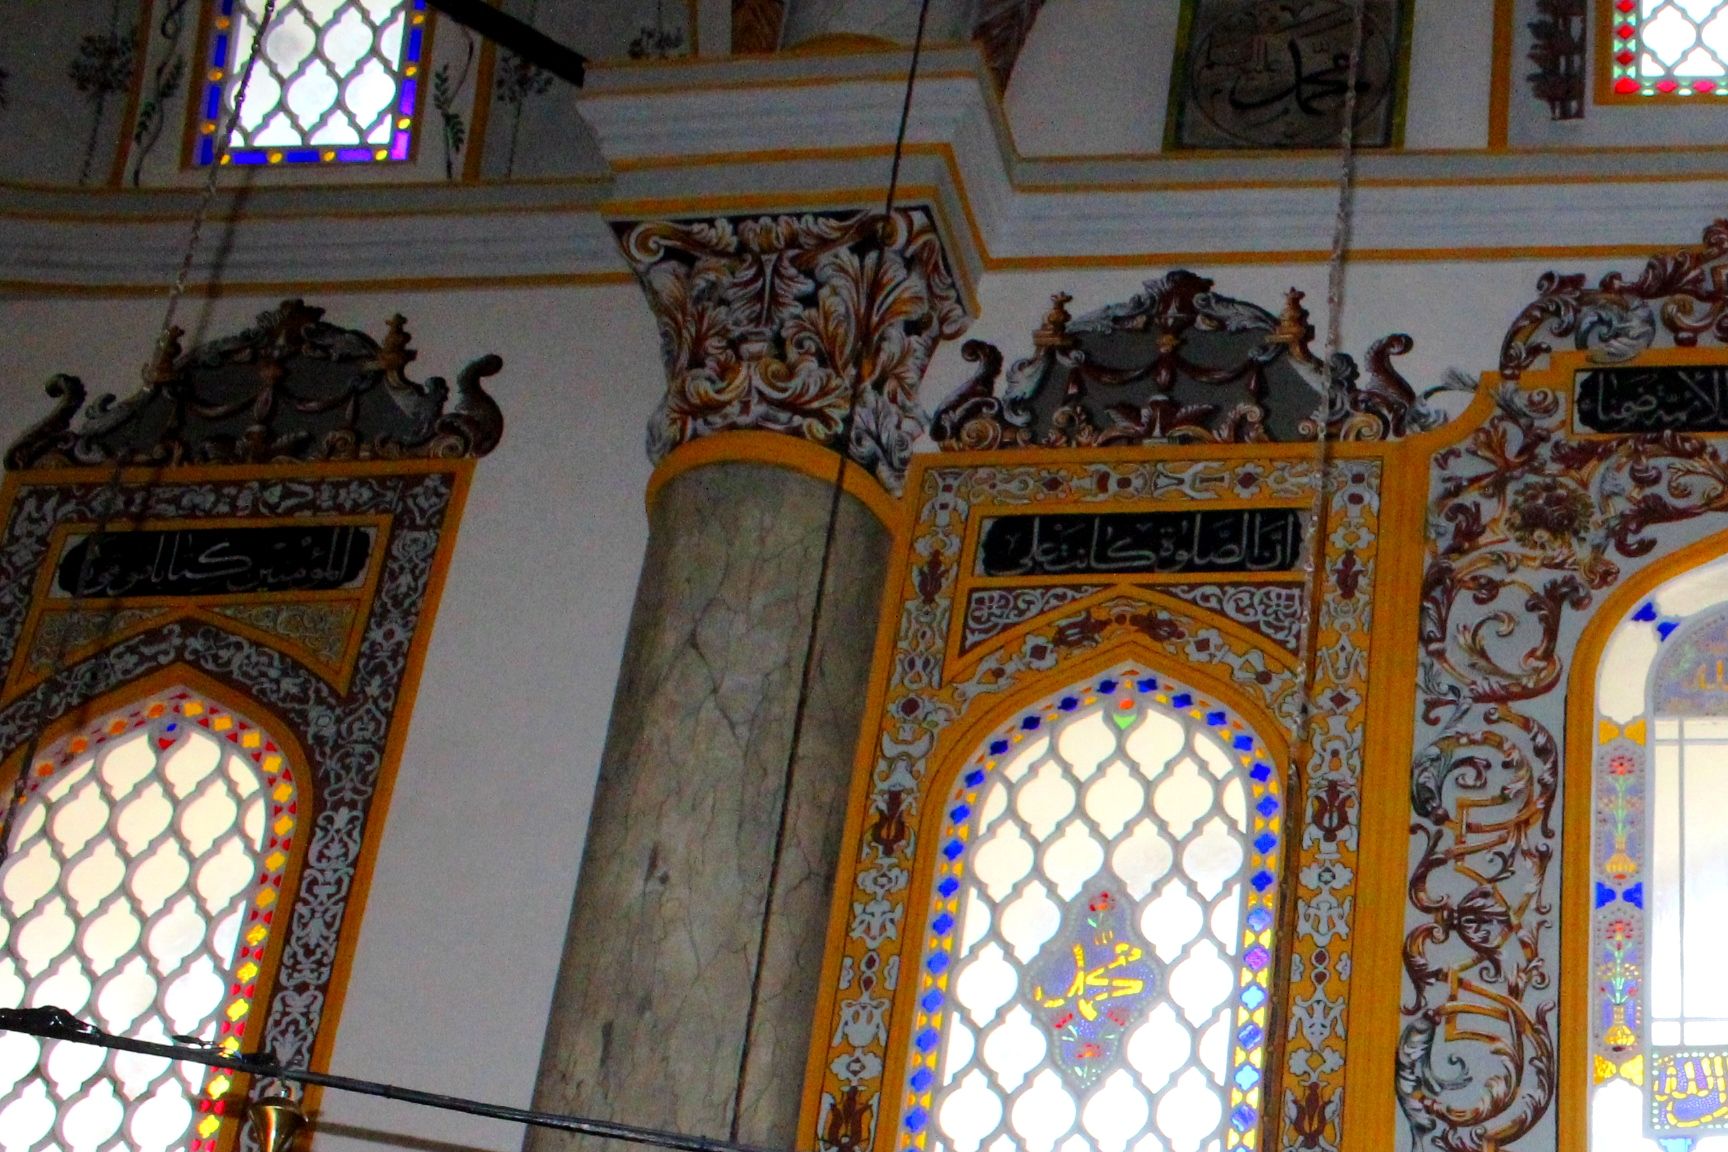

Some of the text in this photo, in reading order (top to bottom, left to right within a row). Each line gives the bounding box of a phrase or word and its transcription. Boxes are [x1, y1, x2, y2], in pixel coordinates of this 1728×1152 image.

[1228, 38, 1371, 116] محمد
[990, 515, 1059, 576] على
[1033, 938, 1144, 1021] محمد
